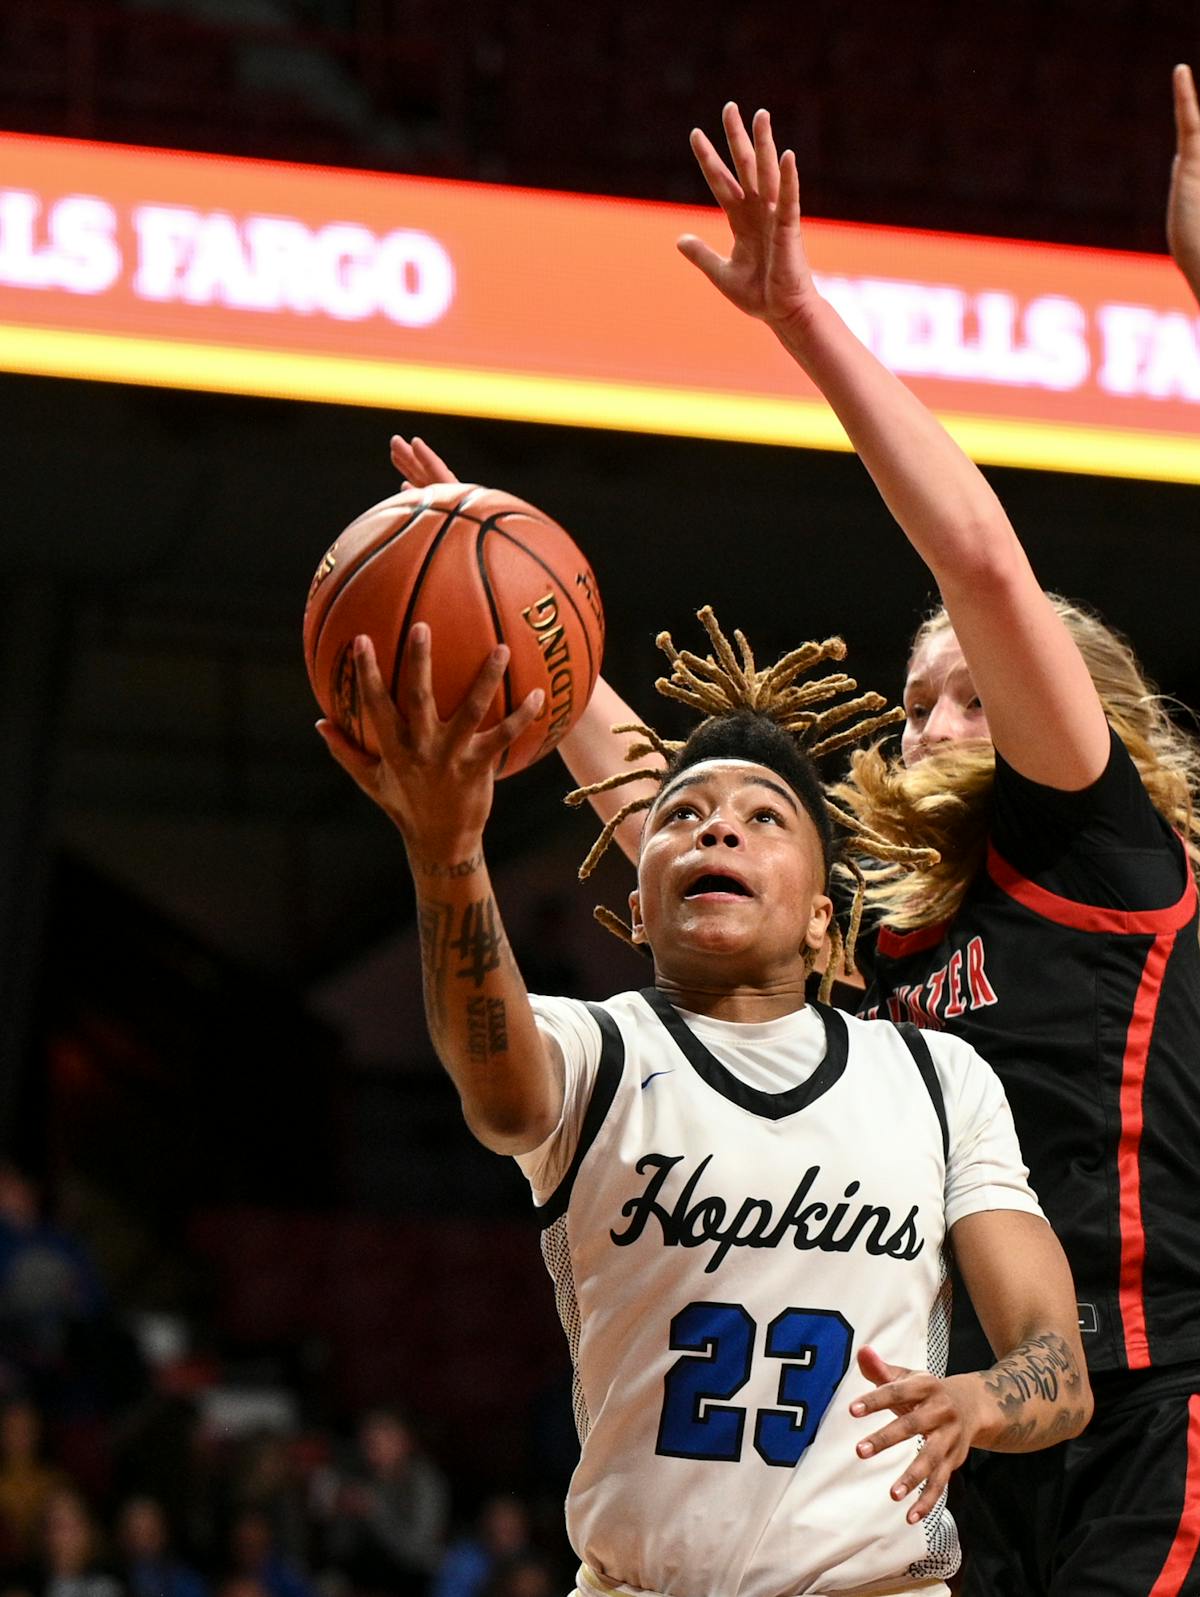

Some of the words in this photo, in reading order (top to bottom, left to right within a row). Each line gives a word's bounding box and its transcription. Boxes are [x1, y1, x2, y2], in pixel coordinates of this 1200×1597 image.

[134, 205, 456, 326] FARGO
[521, 592, 574, 748] ALDING
[610, 1155, 924, 1273] Hopkins
[655, 1301, 854, 1467] 23
